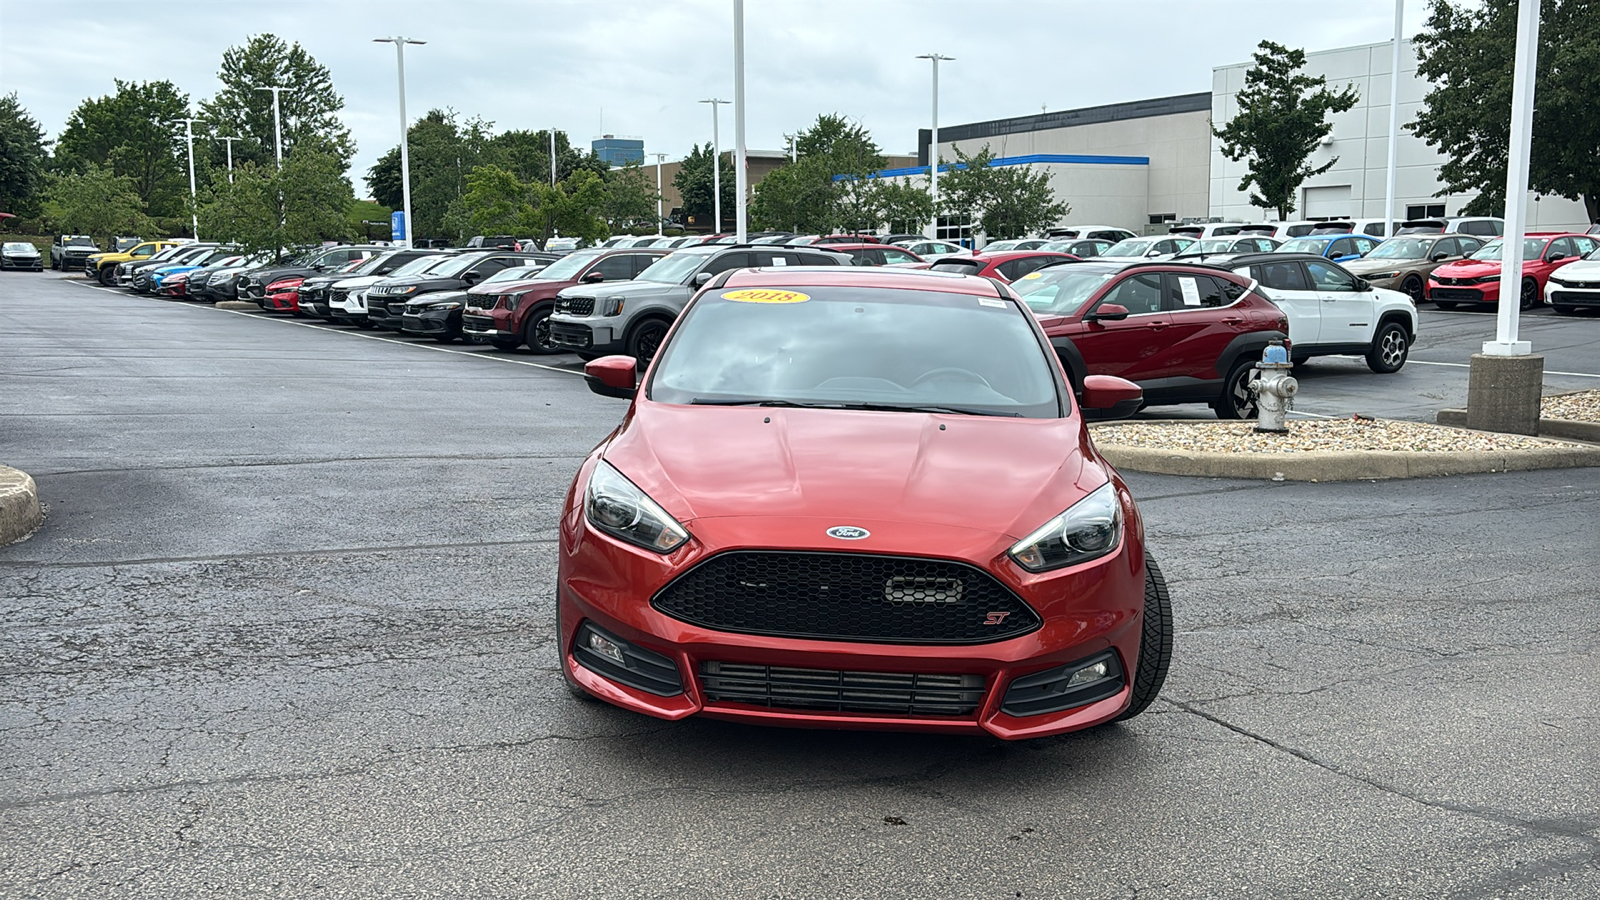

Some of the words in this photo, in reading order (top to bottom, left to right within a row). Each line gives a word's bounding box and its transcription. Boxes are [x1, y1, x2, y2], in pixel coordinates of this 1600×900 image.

[734, 291, 798, 302] 2018
[836, 527, 860, 537] Ford
[983, 611, 1011, 625] ST
